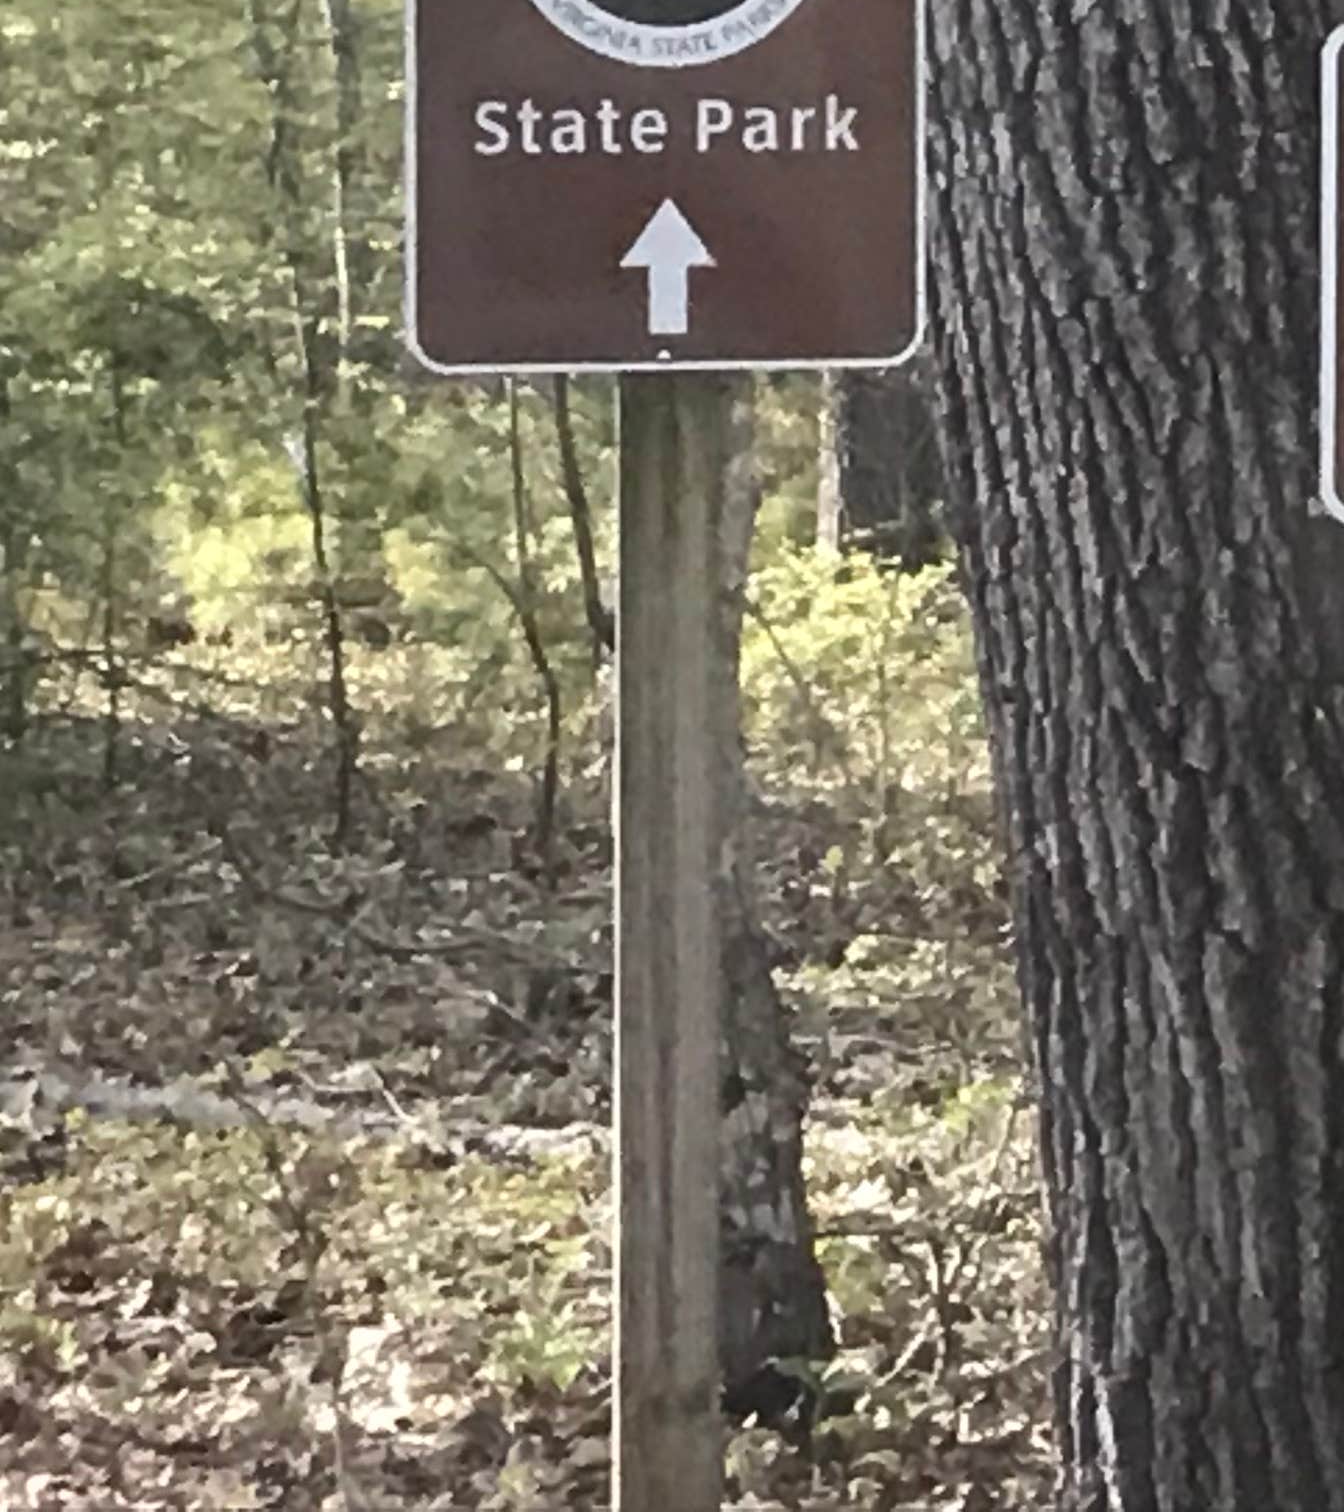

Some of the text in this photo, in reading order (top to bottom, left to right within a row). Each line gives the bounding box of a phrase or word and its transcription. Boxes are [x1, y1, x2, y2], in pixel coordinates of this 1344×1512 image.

[650, 29, 717, 56] STATE
[474, 94, 859, 154] State Park
